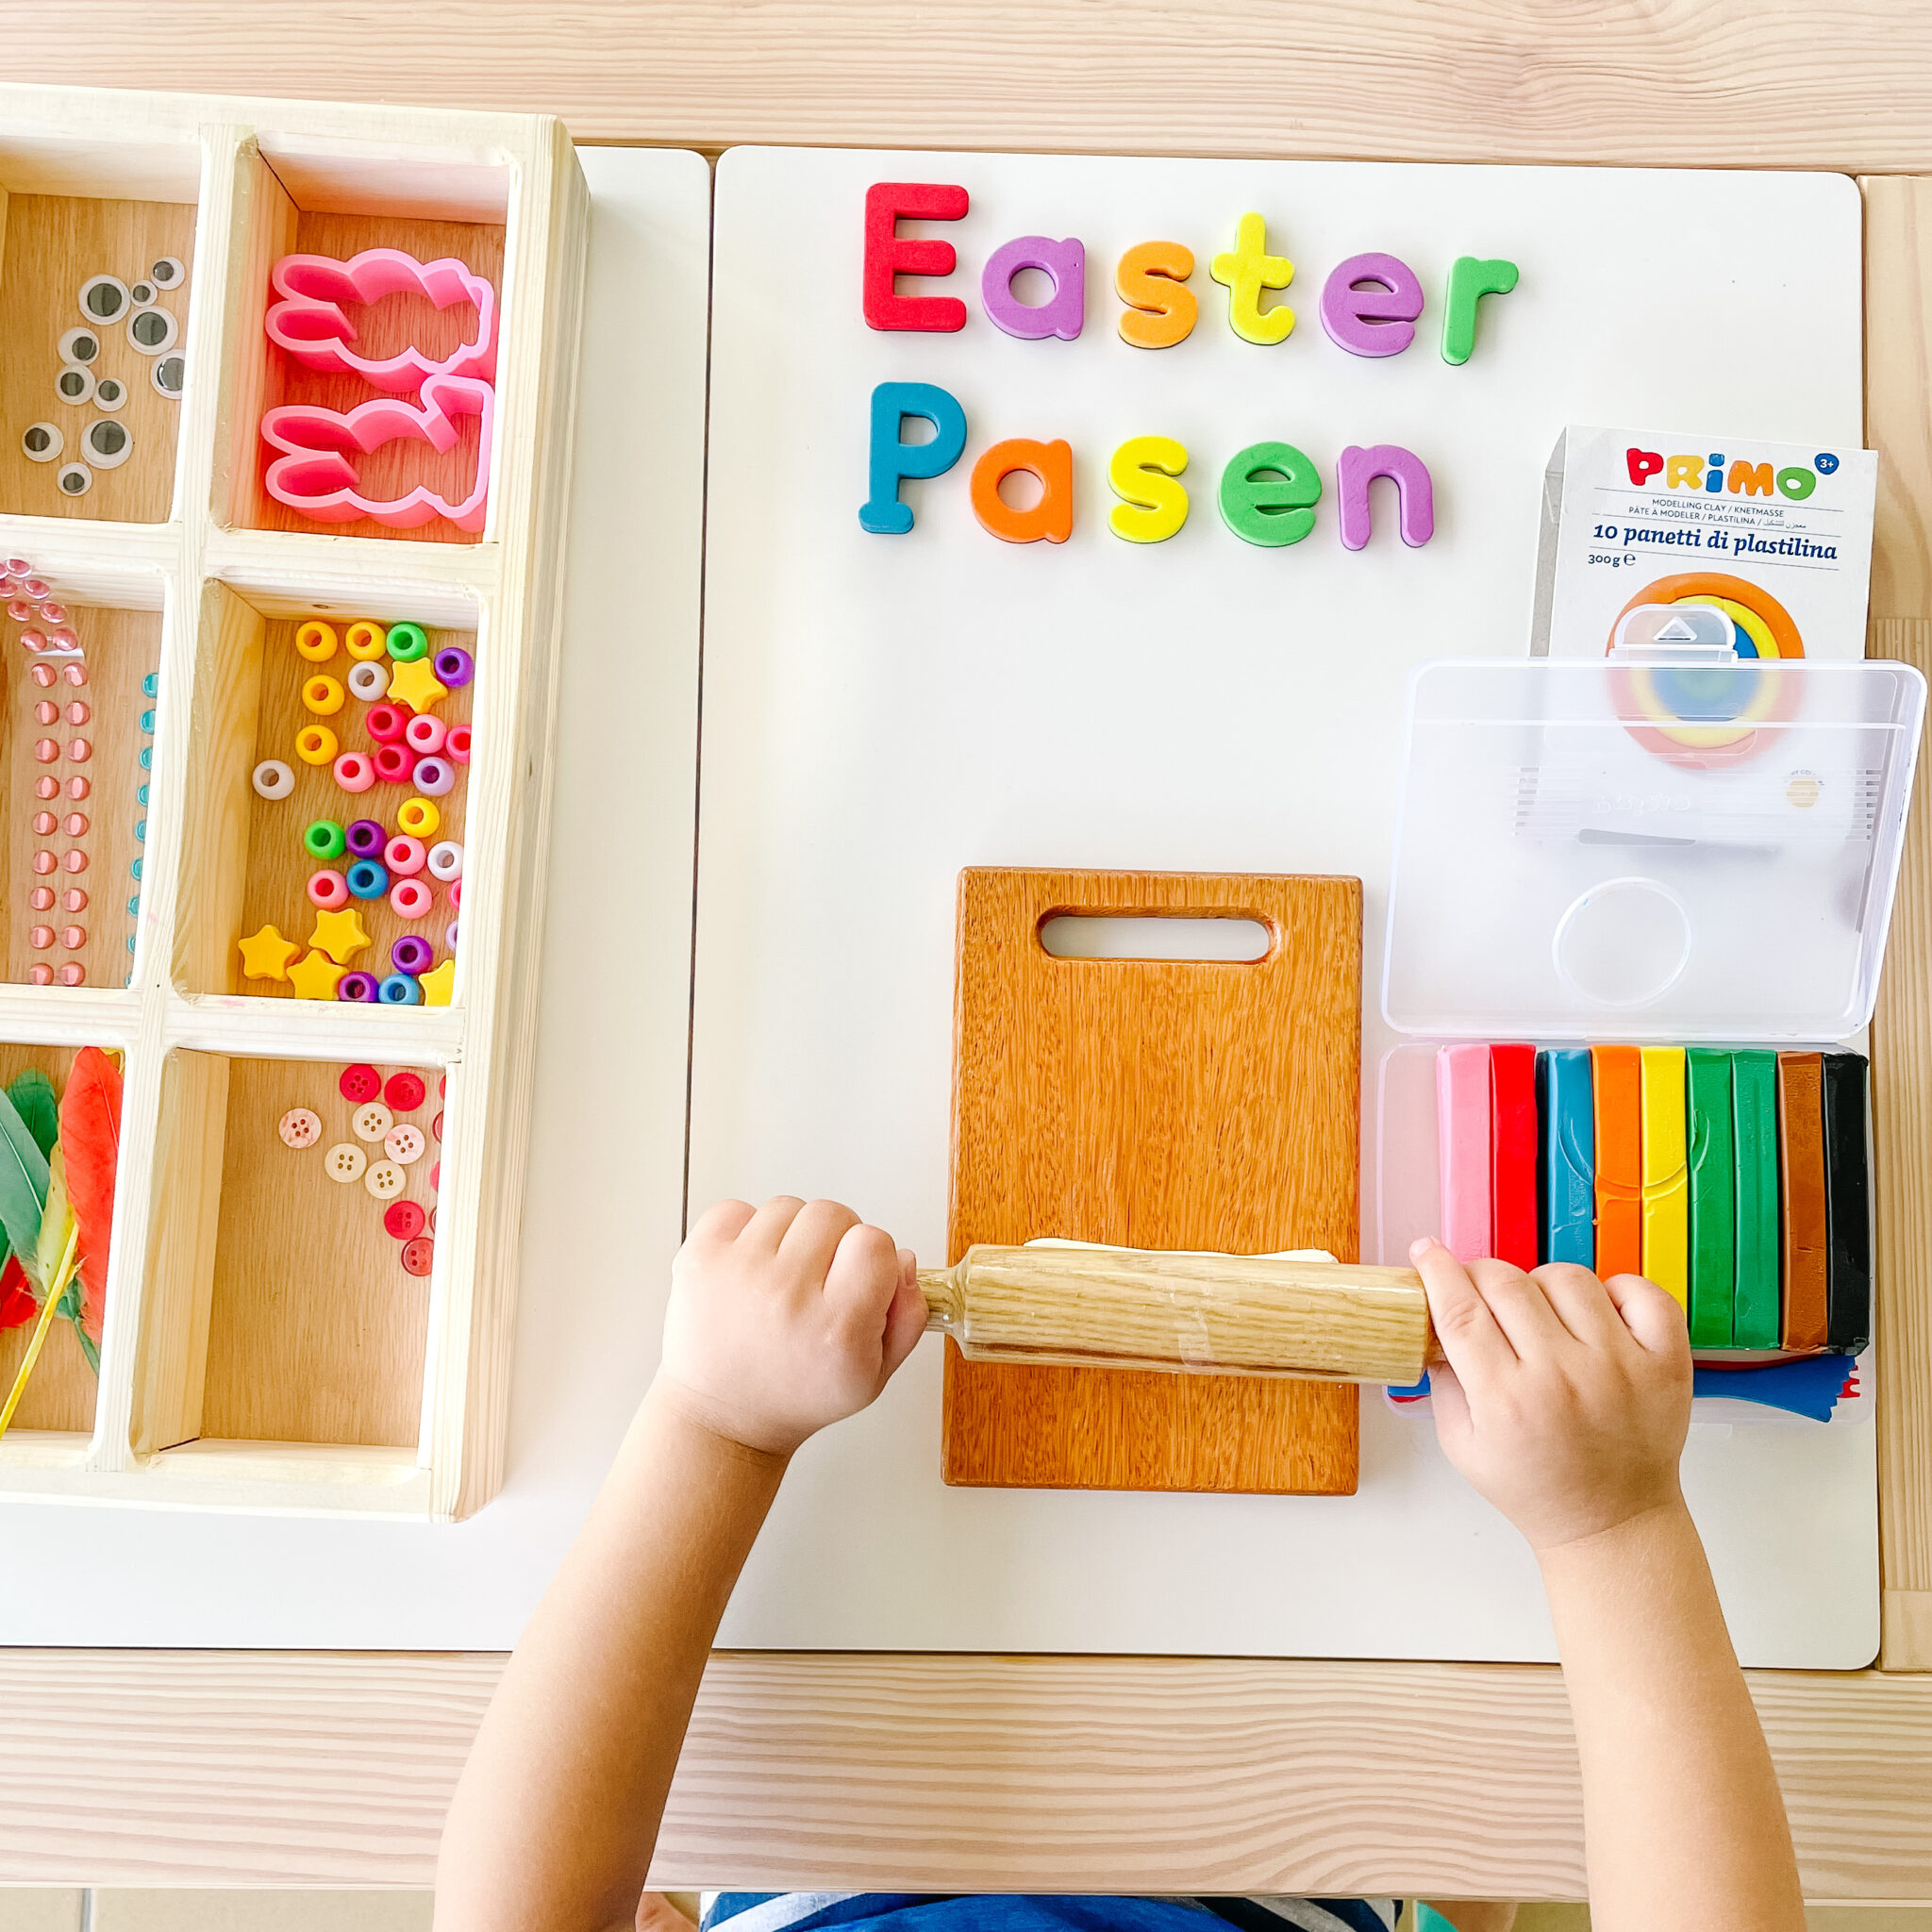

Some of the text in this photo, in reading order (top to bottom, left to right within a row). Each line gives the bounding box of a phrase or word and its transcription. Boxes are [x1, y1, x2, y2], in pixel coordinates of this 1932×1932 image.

[863, 182, 1520, 366] Easter
[858, 382, 1435, 551] Pasen
[1820, 458, 1835, 470] 3+
[1652, 499, 1702, 509] MODELLING
[1704, 503, 1726, 511] CLAY
[1734, 507, 1784, 517] KNETMASSE
[1660, 510, 1700, 520] MODELER
[1708, 514, 1756, 525] PLASTILINA
[1593, 525, 1838, 559] 10 panetti di plastilina
